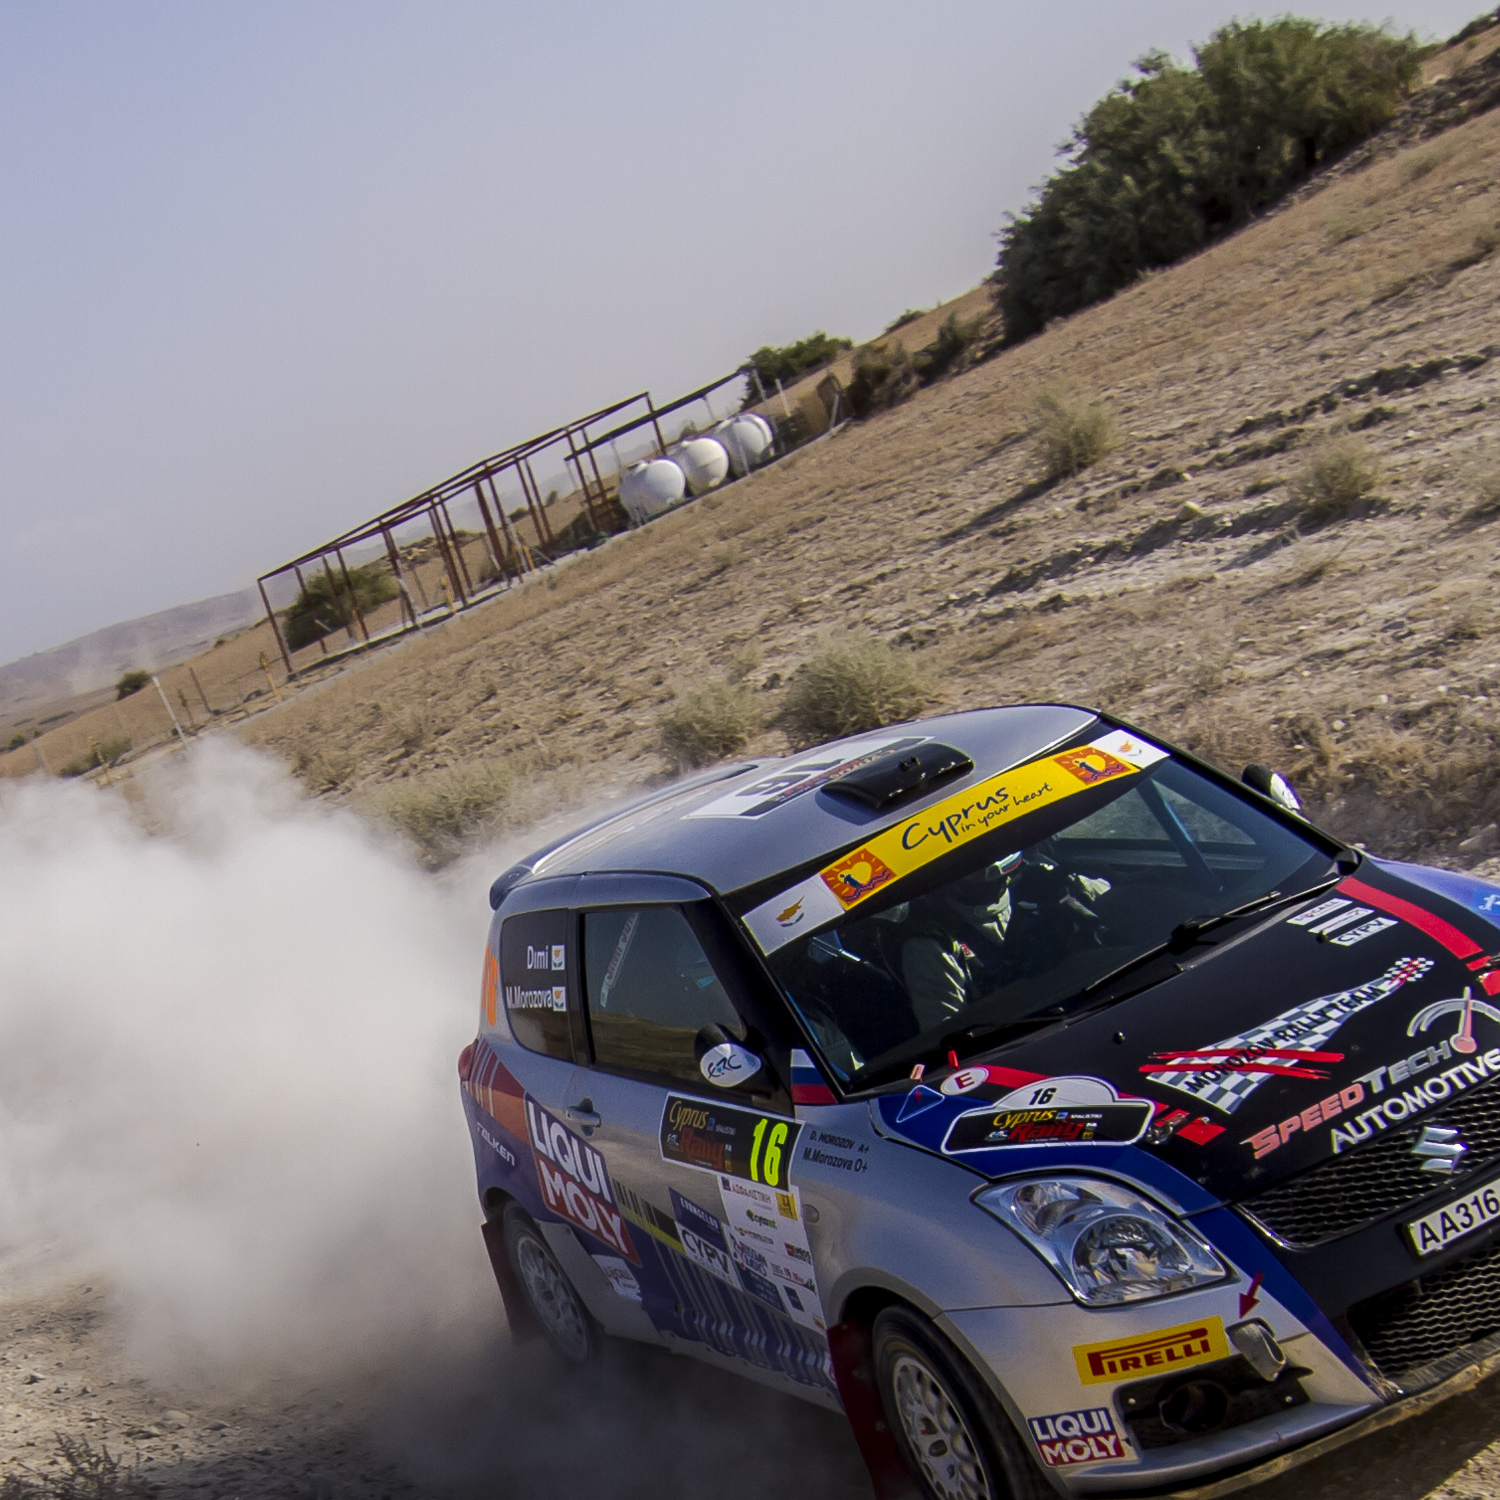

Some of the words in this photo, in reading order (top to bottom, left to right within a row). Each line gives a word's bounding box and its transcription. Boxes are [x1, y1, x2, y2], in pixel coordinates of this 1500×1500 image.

[902, 787, 1009, 850] Cyprus
[961, 822, 976, 833] in
[978, 804, 1009, 827] your
[1013, 782, 1053, 806] heart
[1337, 919, 1384, 942] CYPV
[527, 945, 549, 969] Dimi
[1184, 1037, 1276, 1094] MOROZOV
[1274, 1009, 1333, 1042] RALLY
[1331, 985, 1387, 1018] TEAM
[954, 1072, 975, 1089] E
[1029, 1087, 1057, 1105] 16
[669, 1101, 709, 1131] Cyprus
[993, 1110, 1057, 1129] Cyprus
[818, 1132, 855, 1149] MOROZOV
[1008, 1122, 1084, 1142] Rally
[528, 1101, 612, 1203] LIQUI
[679, 1127, 725, 1169] Rally
[750, 1118, 788, 1187] 16
[540, 1159, 628, 1254] MOLY
[682, 1229, 729, 1274] CYPV
[1087, 1327, 1211, 1377] PIRELLI
[1032, 1410, 1112, 1441] LIQUI
[1041, 1434, 1119, 1464] MOLY
